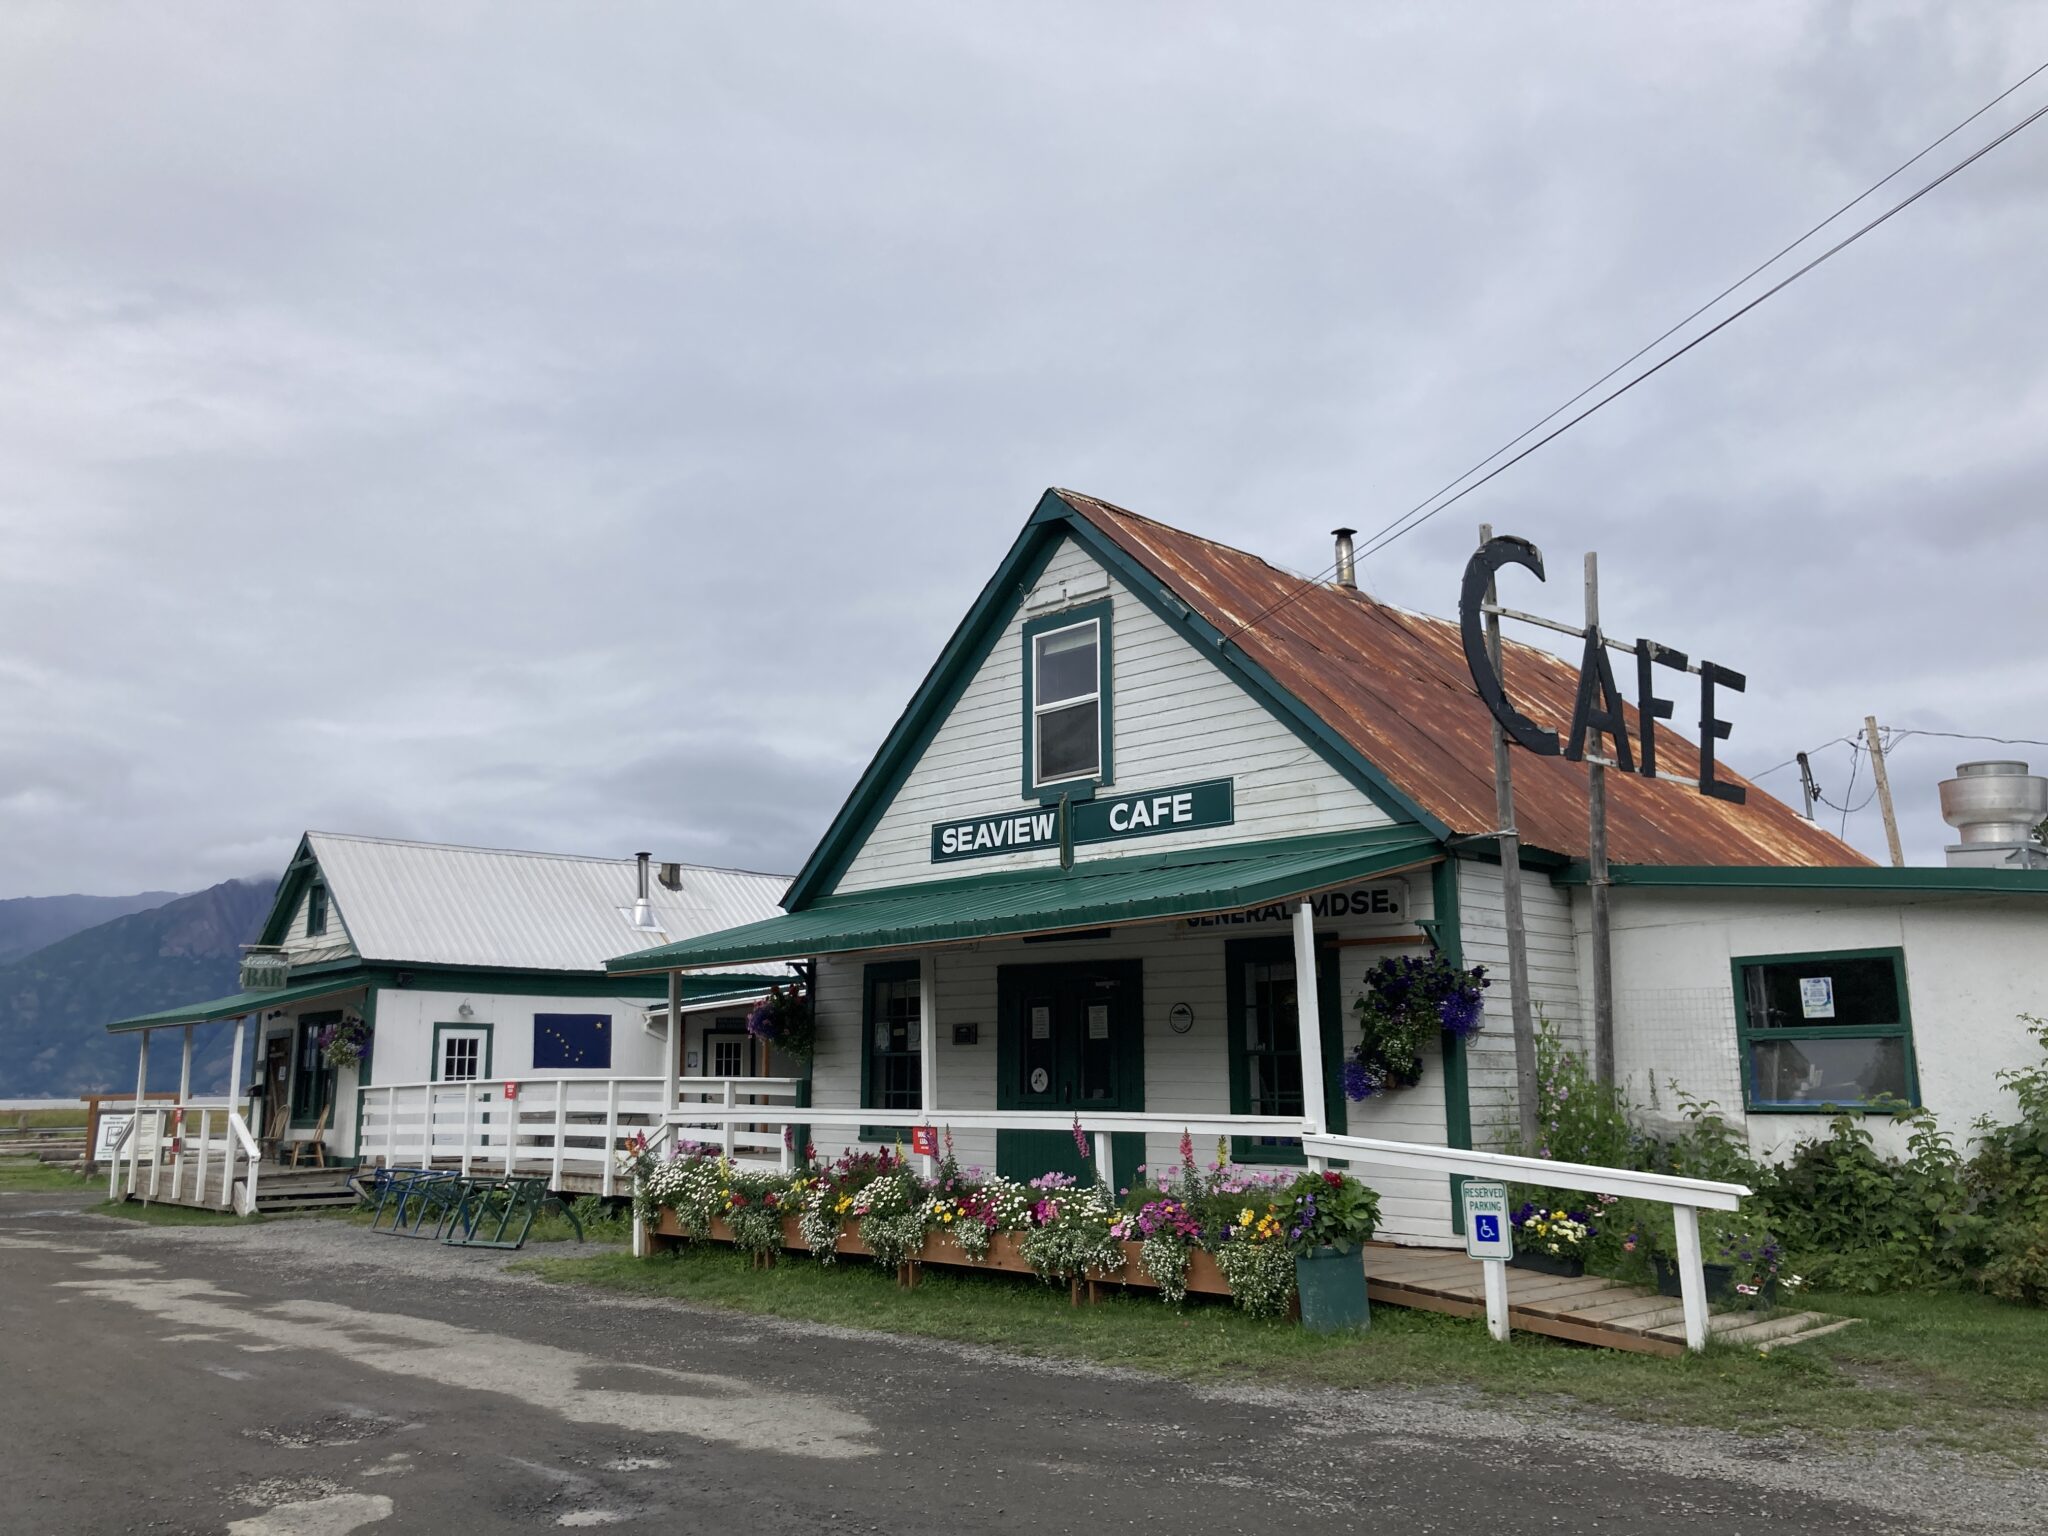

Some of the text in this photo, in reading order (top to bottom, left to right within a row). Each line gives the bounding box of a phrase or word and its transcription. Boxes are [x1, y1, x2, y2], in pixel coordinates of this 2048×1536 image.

[1458, 534, 1747, 806] CAFE
[941, 792, 1193, 855] SEAVIEW CAFE
[1310, 889, 1398, 917] MDSE.
[245, 967, 283, 988] BAR
[1464, 1187, 1504, 1198] RESERVED
[1469, 1200, 1502, 1212] PARKING
